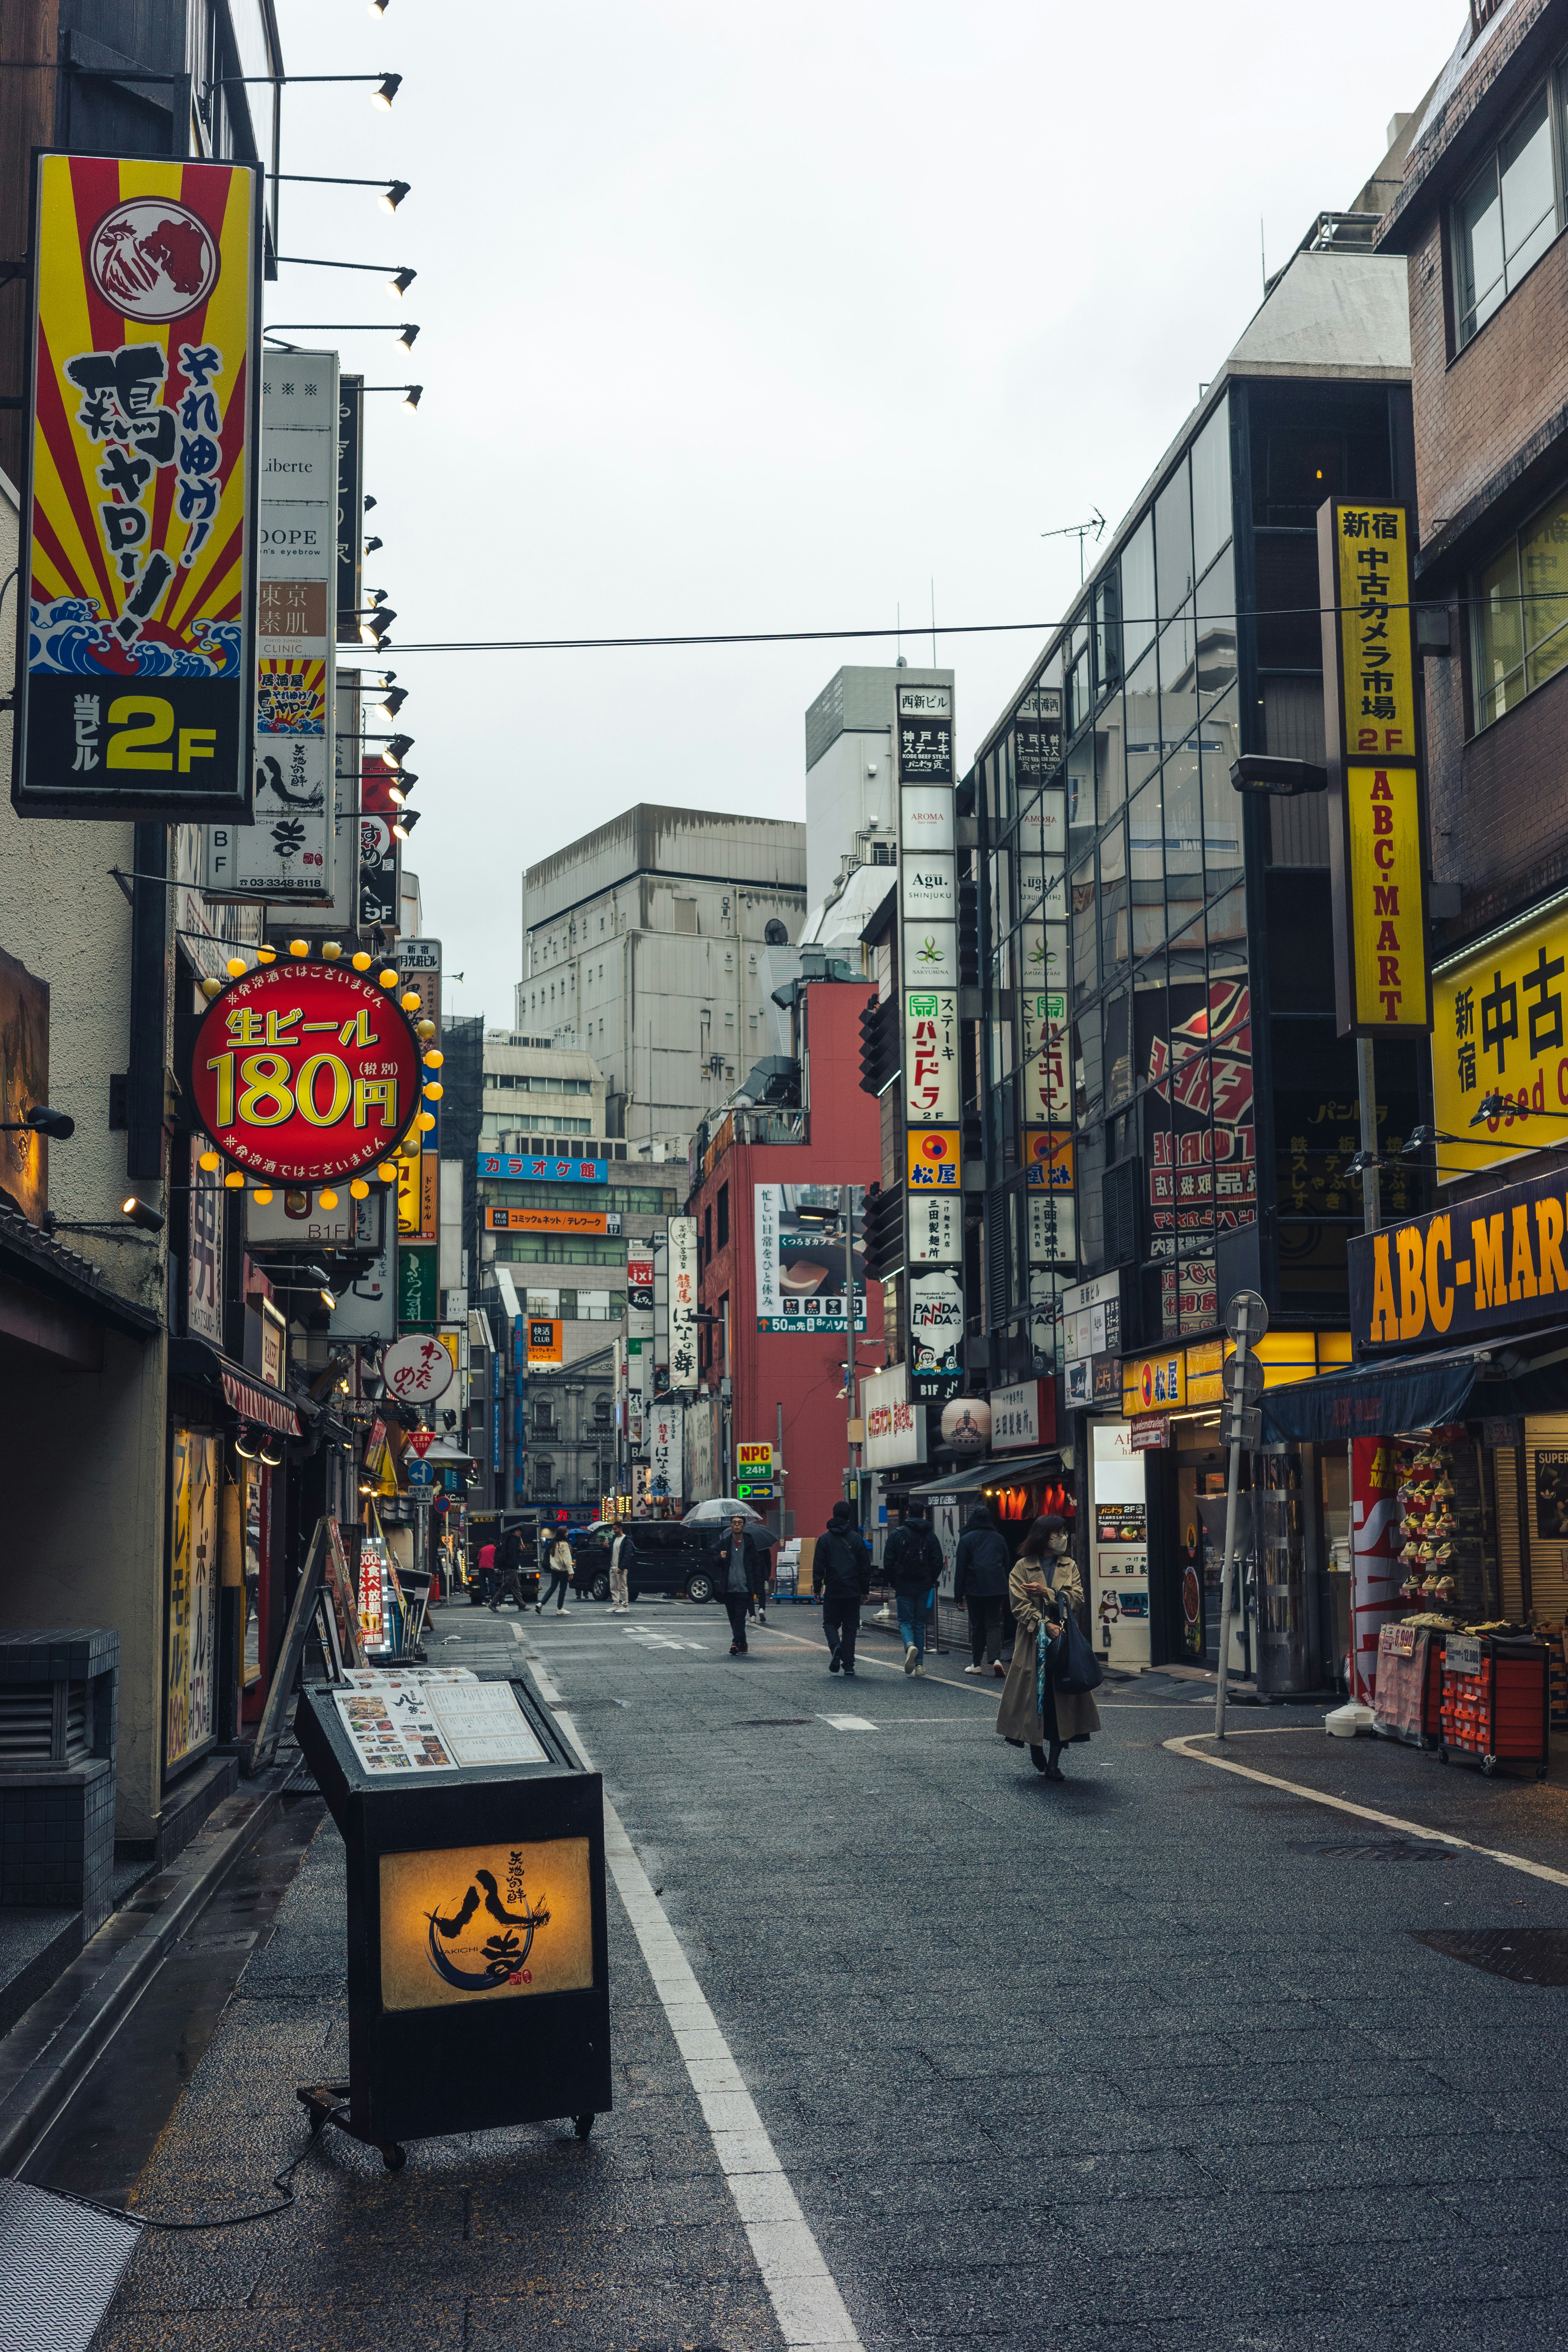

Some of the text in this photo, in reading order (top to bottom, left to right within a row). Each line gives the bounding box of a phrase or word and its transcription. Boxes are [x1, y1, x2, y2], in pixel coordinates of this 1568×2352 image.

[1343, 511, 1398, 539] 新宿
[260, 584, 308, 607] 東京
[259, 611, 308, 634] 素肌
[1357, 547, 1396, 720] 中古カメラ市場
[264, 644, 302, 653] CLINIC
[260, 673, 304, 688] 居酒屋
[902, 695, 947, 709] 西新ビル
[71, 694, 100, 771] 当ビル
[107, 695, 216, 772] 2F
[903, 731, 949, 743] 神戸牛
[1358, 728, 1402, 751] 2F
[904, 743, 949, 754] ステーキ
[250, 878, 321, 887] 03-3348-8118
[912, 873, 948, 889] Agu.
[1370, 770, 1402, 1022] ABC-MART
[365, 906, 392, 920] 5F
[407, 945, 429, 955] 新宿
[1481, 946, 1564, 1074] 中古
[225, 1007, 378, 1047] 生ビール
[941, 998, 955, 1060] ステーキ
[1455, 985, 1477, 1094] 新宿
[910, 1020, 939, 1109] パンドラ
[1486, 1068, 1544, 1133] Used
[485, 1157, 596, 1179] カラオケ館
[911, 1163, 956, 1185] 松屋
[423, 1176, 432, 1220] ドンちゃん
[309, 1224, 346, 1239] B1F
[567, 1217, 601, 1226] テレワーク
[928, 1200, 940, 1259] 三田製麺所
[761, 1189, 773, 1312] 忙しい日常をひと休み。
[782, 1238, 835, 1246] くつろぎカフェ
[633, 1269, 652, 1281] ixi
[1370, 1192, 1568, 1342] ABC-MAR
[675, 1274, 691, 1303] 龍馬
[913, 1302, 960, 1314] PANDA
[534, 1327, 550, 1335] 快活
[772, 1318, 805, 1331] 50m先
[913, 1314, 953, 1326] LINDA
[416, 1341, 442, 1390] わんたん
[394, 1366, 415, 1395] めん
[920, 1384, 938, 1396] B1F
[1154, 1359, 1178, 1403] 松屋
[996, 1408, 1029, 1437] 三田製麺所
[741, 1446, 769, 1461] NPC
[739, 1485, 751, 1499] P
[367, 1566, 381, 1614] 食べ放題
